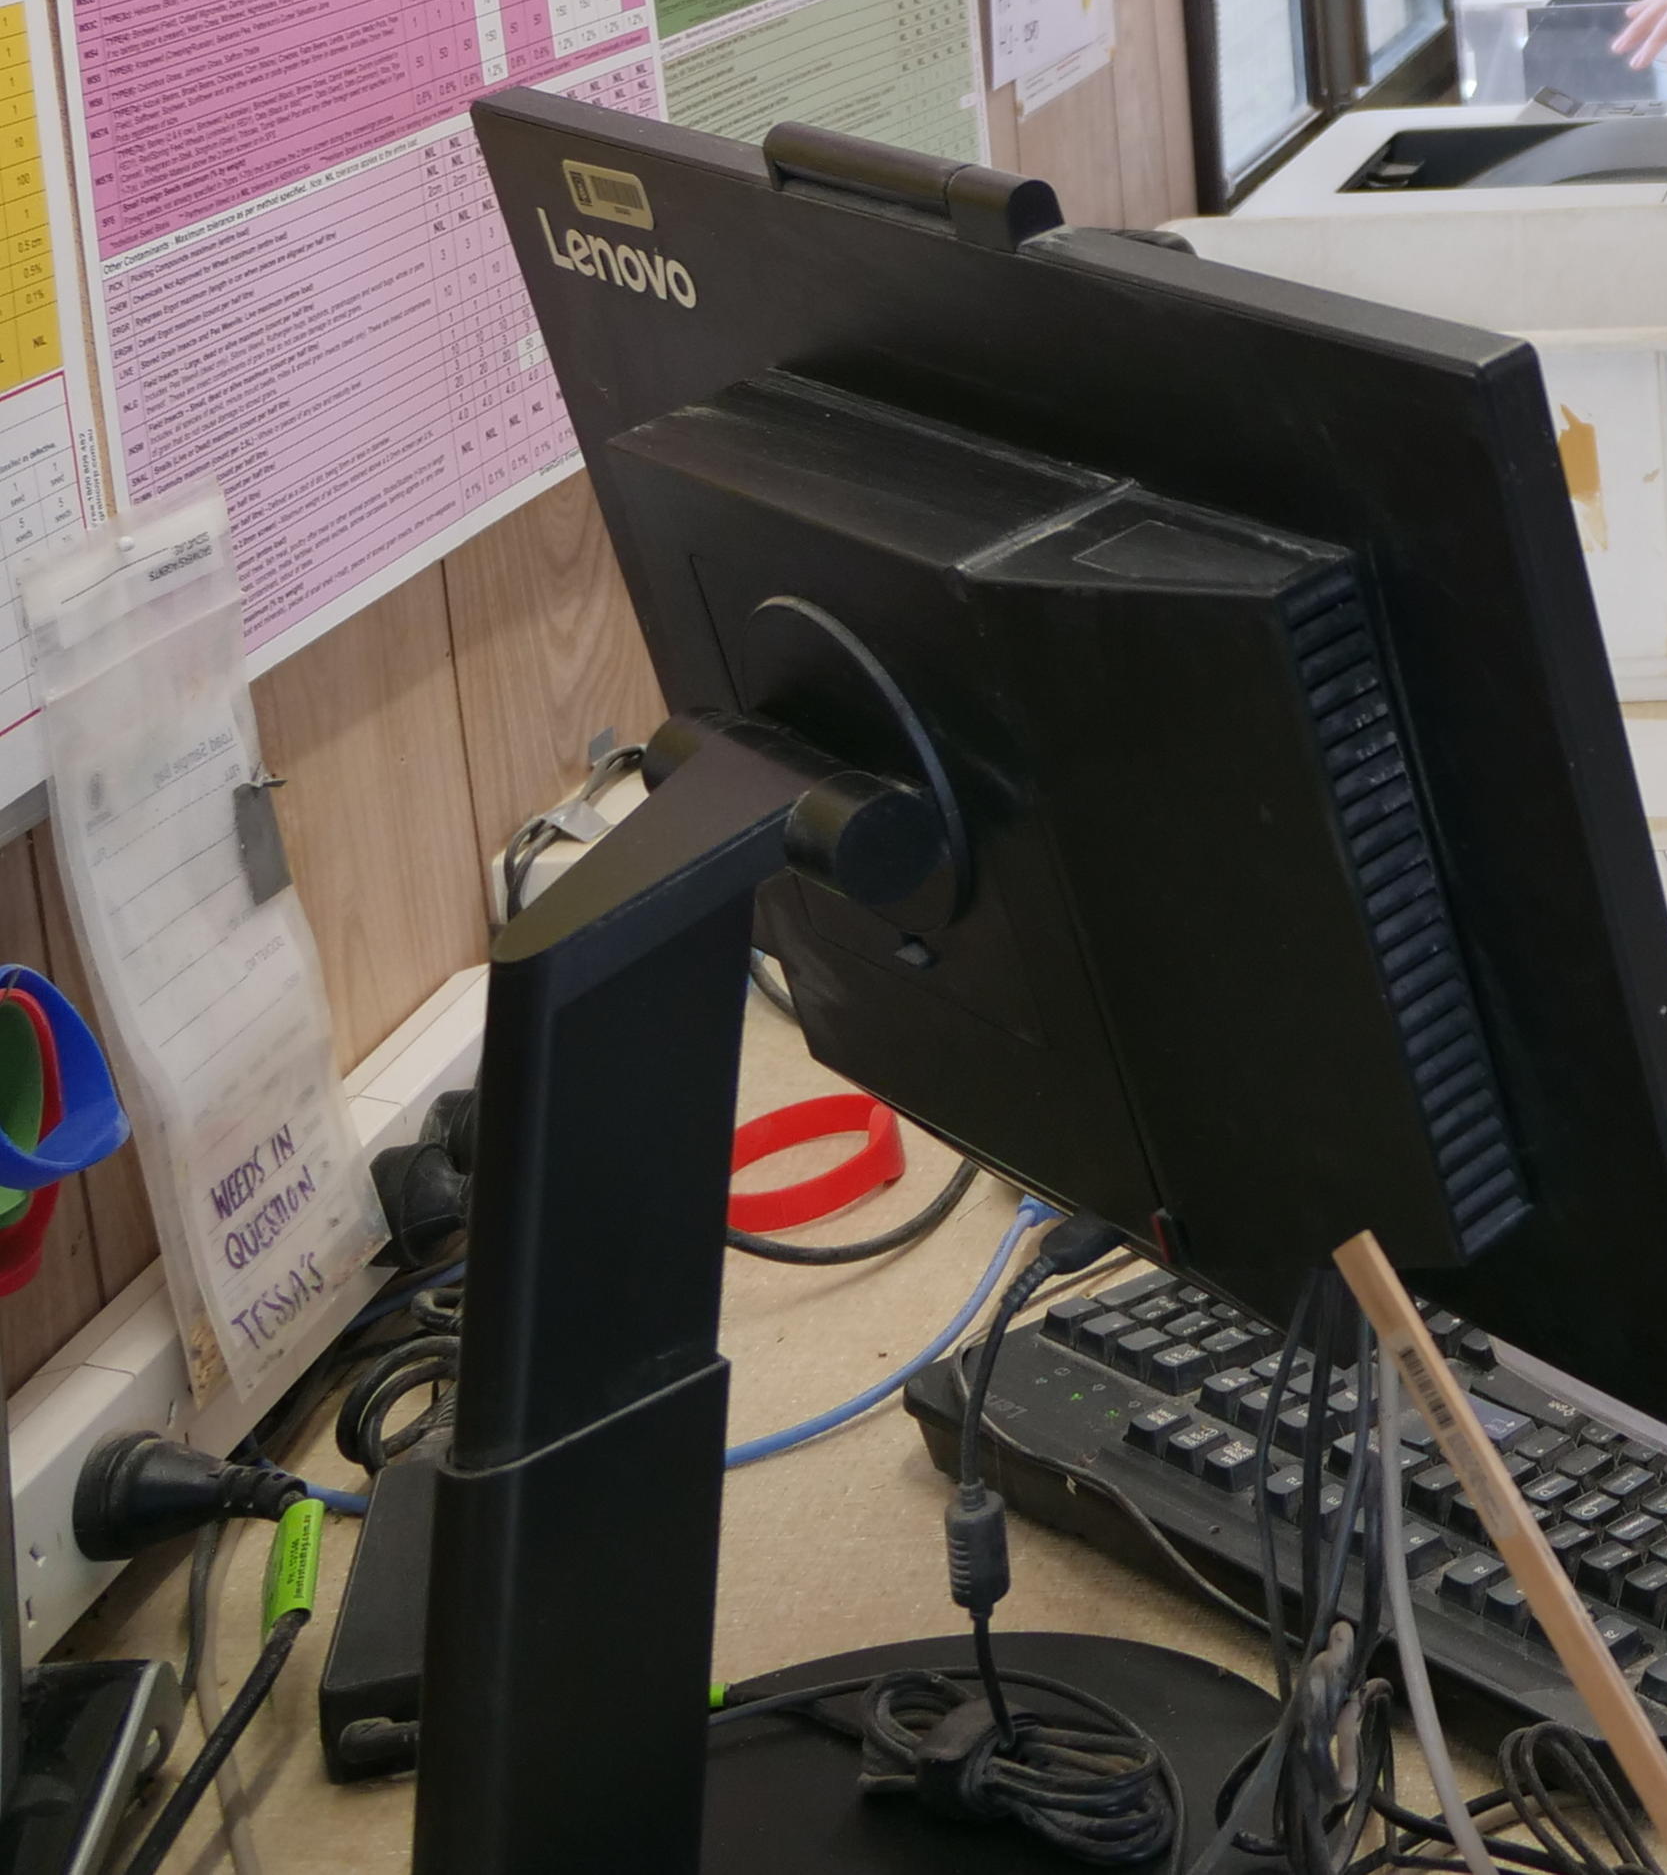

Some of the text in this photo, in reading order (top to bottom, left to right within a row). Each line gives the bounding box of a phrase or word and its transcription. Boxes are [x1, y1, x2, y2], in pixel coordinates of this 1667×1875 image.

[18, 172, 31, 188] 100
[103, 258, 122, 276] Other
[124, 240, 170, 267] Contaminants
[174, 224, 205, 245] Maximum
[206, 215, 235, 234] tolerance
[256, 197, 279, 213] method
[536, 206, 697, 309] Lenovo
[33, 334, 47, 350] NIL
[461, 441, 475, 454] NIL
[464, 482, 482, 501] 0.1%
[210, 1124, 295, 1219] WEEDS IN
[225, 1164, 316, 1269] QUESTION
